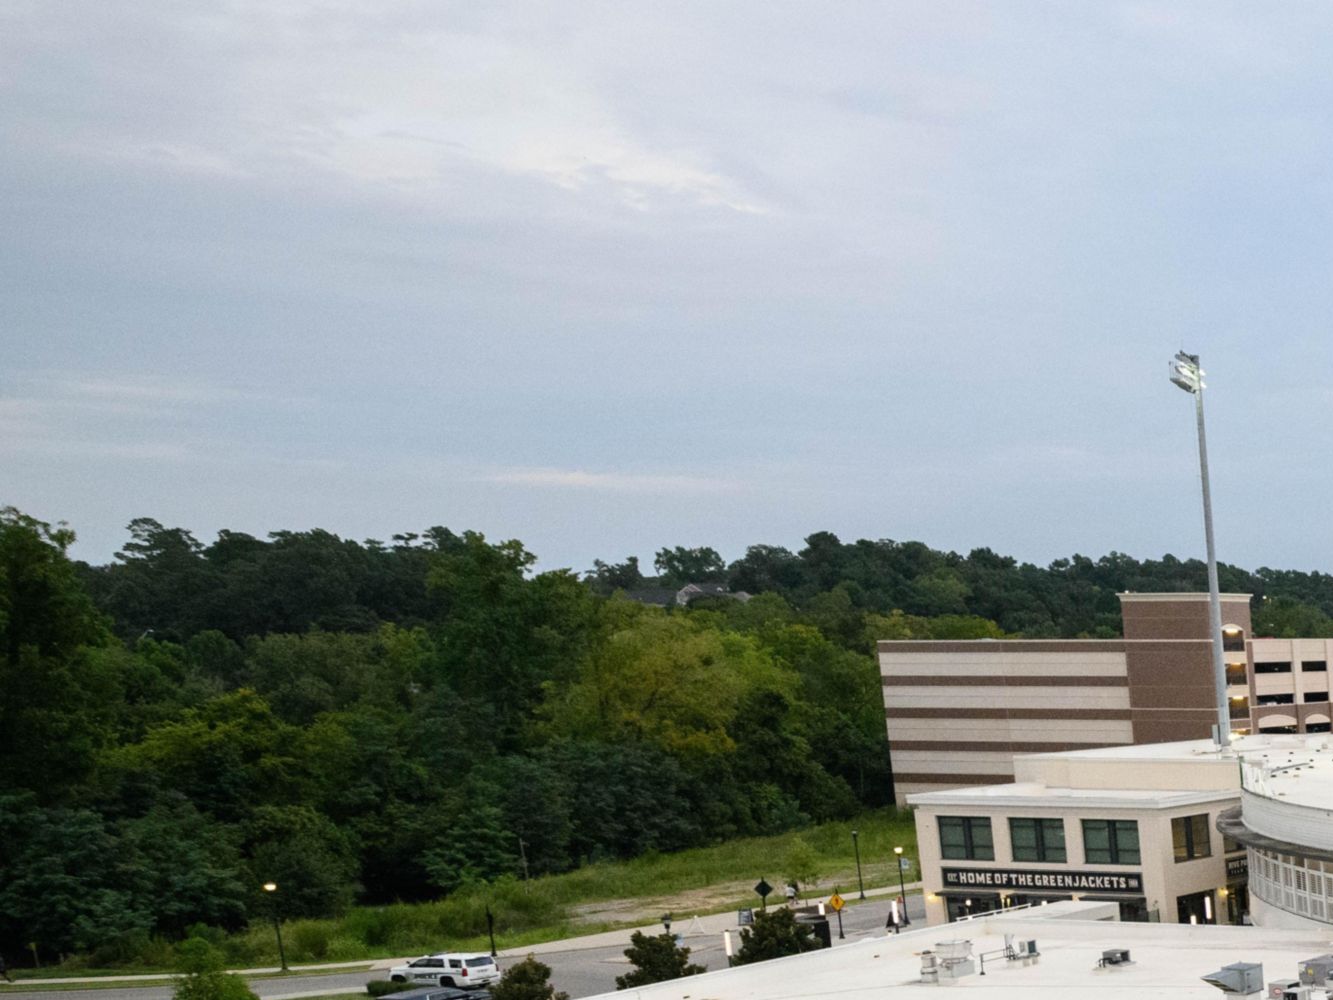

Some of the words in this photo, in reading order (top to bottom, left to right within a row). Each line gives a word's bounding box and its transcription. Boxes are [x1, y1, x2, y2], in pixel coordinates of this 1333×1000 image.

[959, 871, 993, 884] HOME
[994, 873, 1008, 884] OF
[1009, 874, 1034, 886] THE
